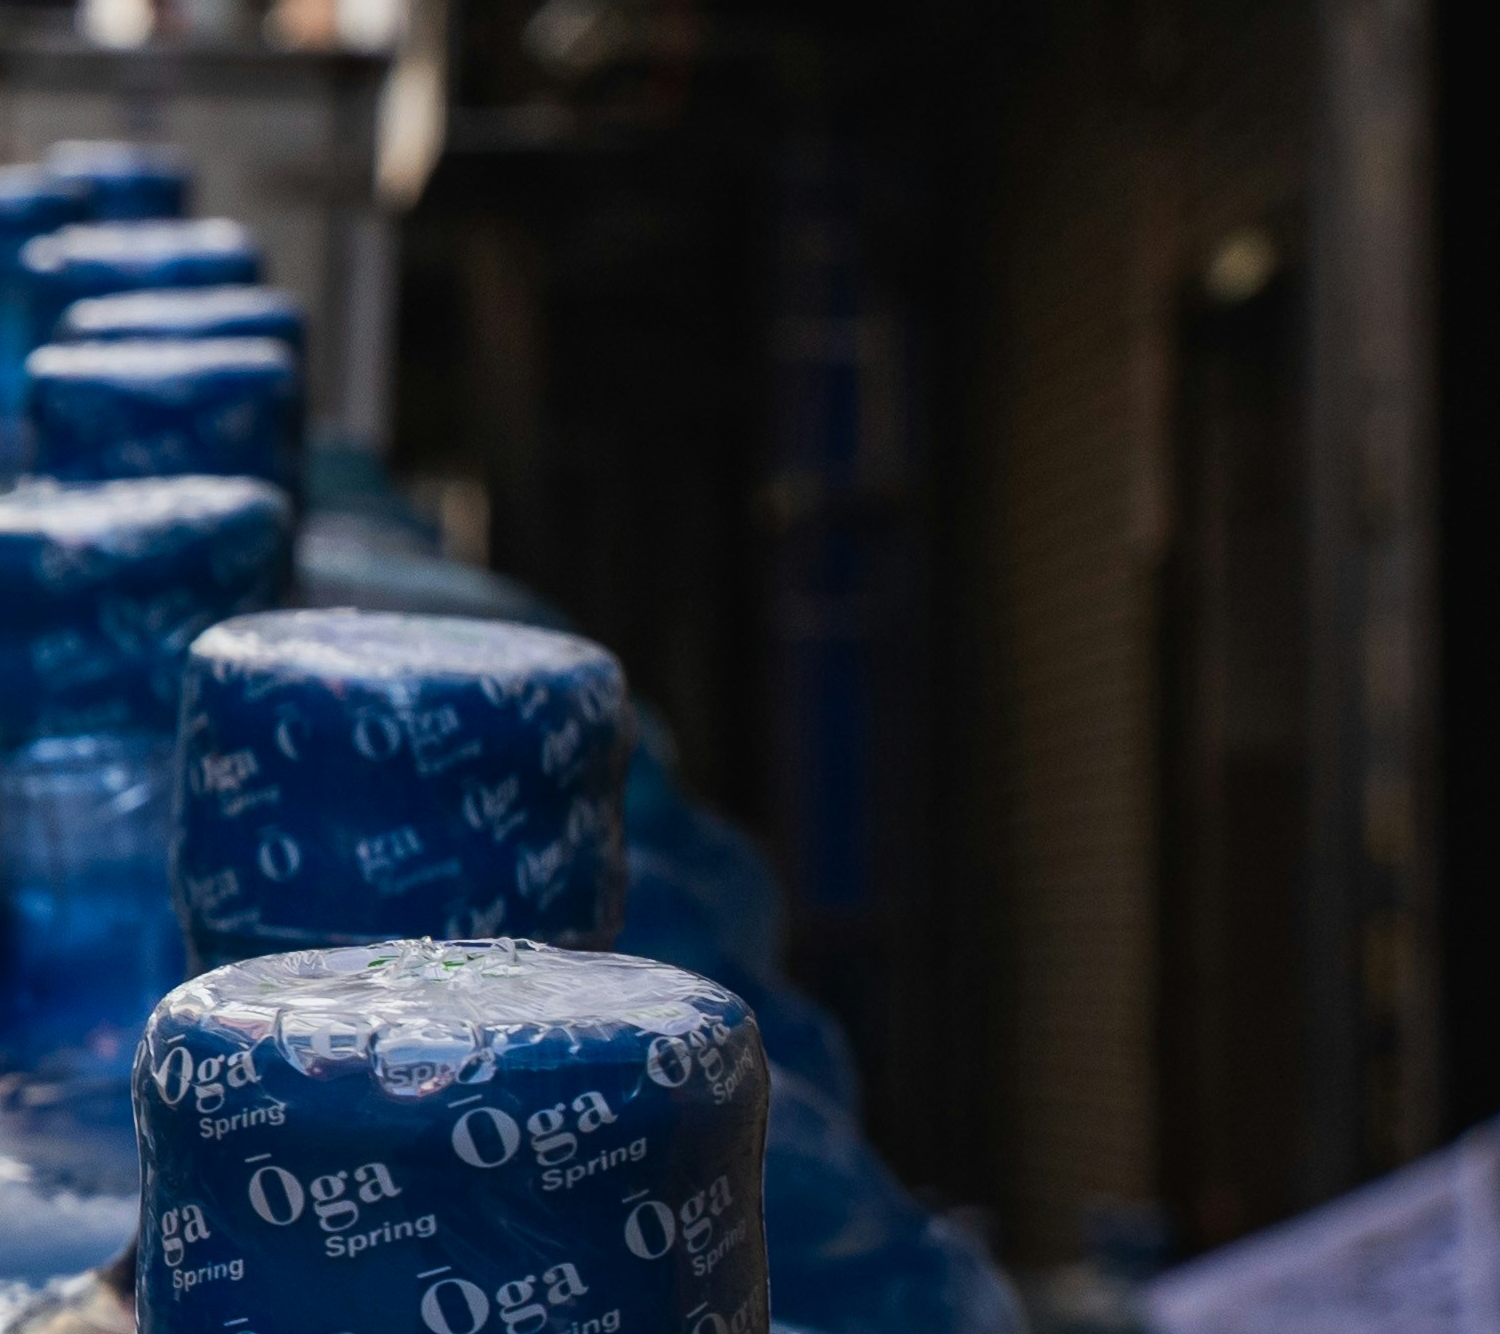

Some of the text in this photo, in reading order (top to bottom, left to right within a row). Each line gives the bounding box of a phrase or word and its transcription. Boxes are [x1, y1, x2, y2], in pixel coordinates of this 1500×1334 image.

[199, 1103, 288, 1140] Spring
[542, 1136, 648, 1192] Spring
[325, 1214, 438, 1258] Spring
[172, 1258, 245, 1293] Spring
